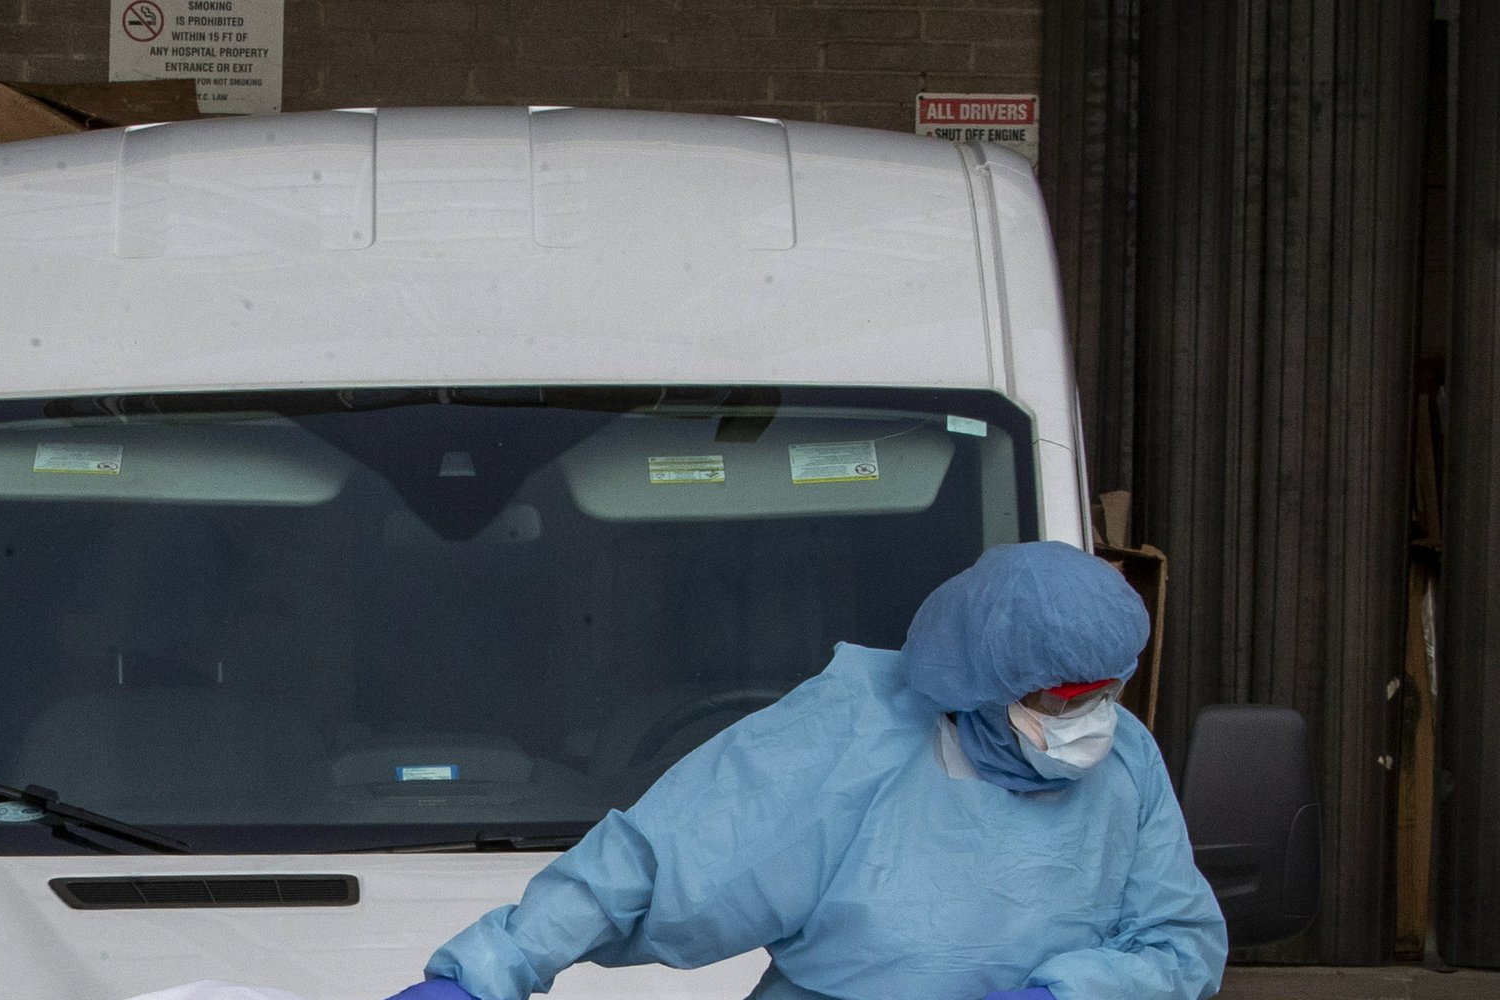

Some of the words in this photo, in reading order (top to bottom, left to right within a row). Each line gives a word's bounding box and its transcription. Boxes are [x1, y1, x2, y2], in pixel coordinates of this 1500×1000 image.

[188, 1, 232, 11] SMOKING
[176, 16, 185, 26] IS
[188, 16, 244, 27] PROHIBITED
[172, 31, 206, 42] WITHIN
[209, 32, 220, 42] 15
[222, 32, 233, 42] FT
[236, 33, 248, 42] OF
[150, 46, 169, 56] ANY
[171, 47, 217, 57] HOSPITAL
[219, 47, 269, 58] PROPERTY
[165, 62, 214, 72] ENTRANCE
[216, 63, 230, 73] OR
[232, 63, 253, 73] EXIT
[196, 78, 211, 86] FOR
[213, 78, 227, 86] NOT
[229, 79, 262, 87] SMOKING
[927, 103, 955, 120] ALL
[960, 104, 1028, 121] DRIVERS
[934, 128, 962, 142] SHUT
[965, 128, 985, 142] OFF
[987, 129, 1026, 142] ENGINE
